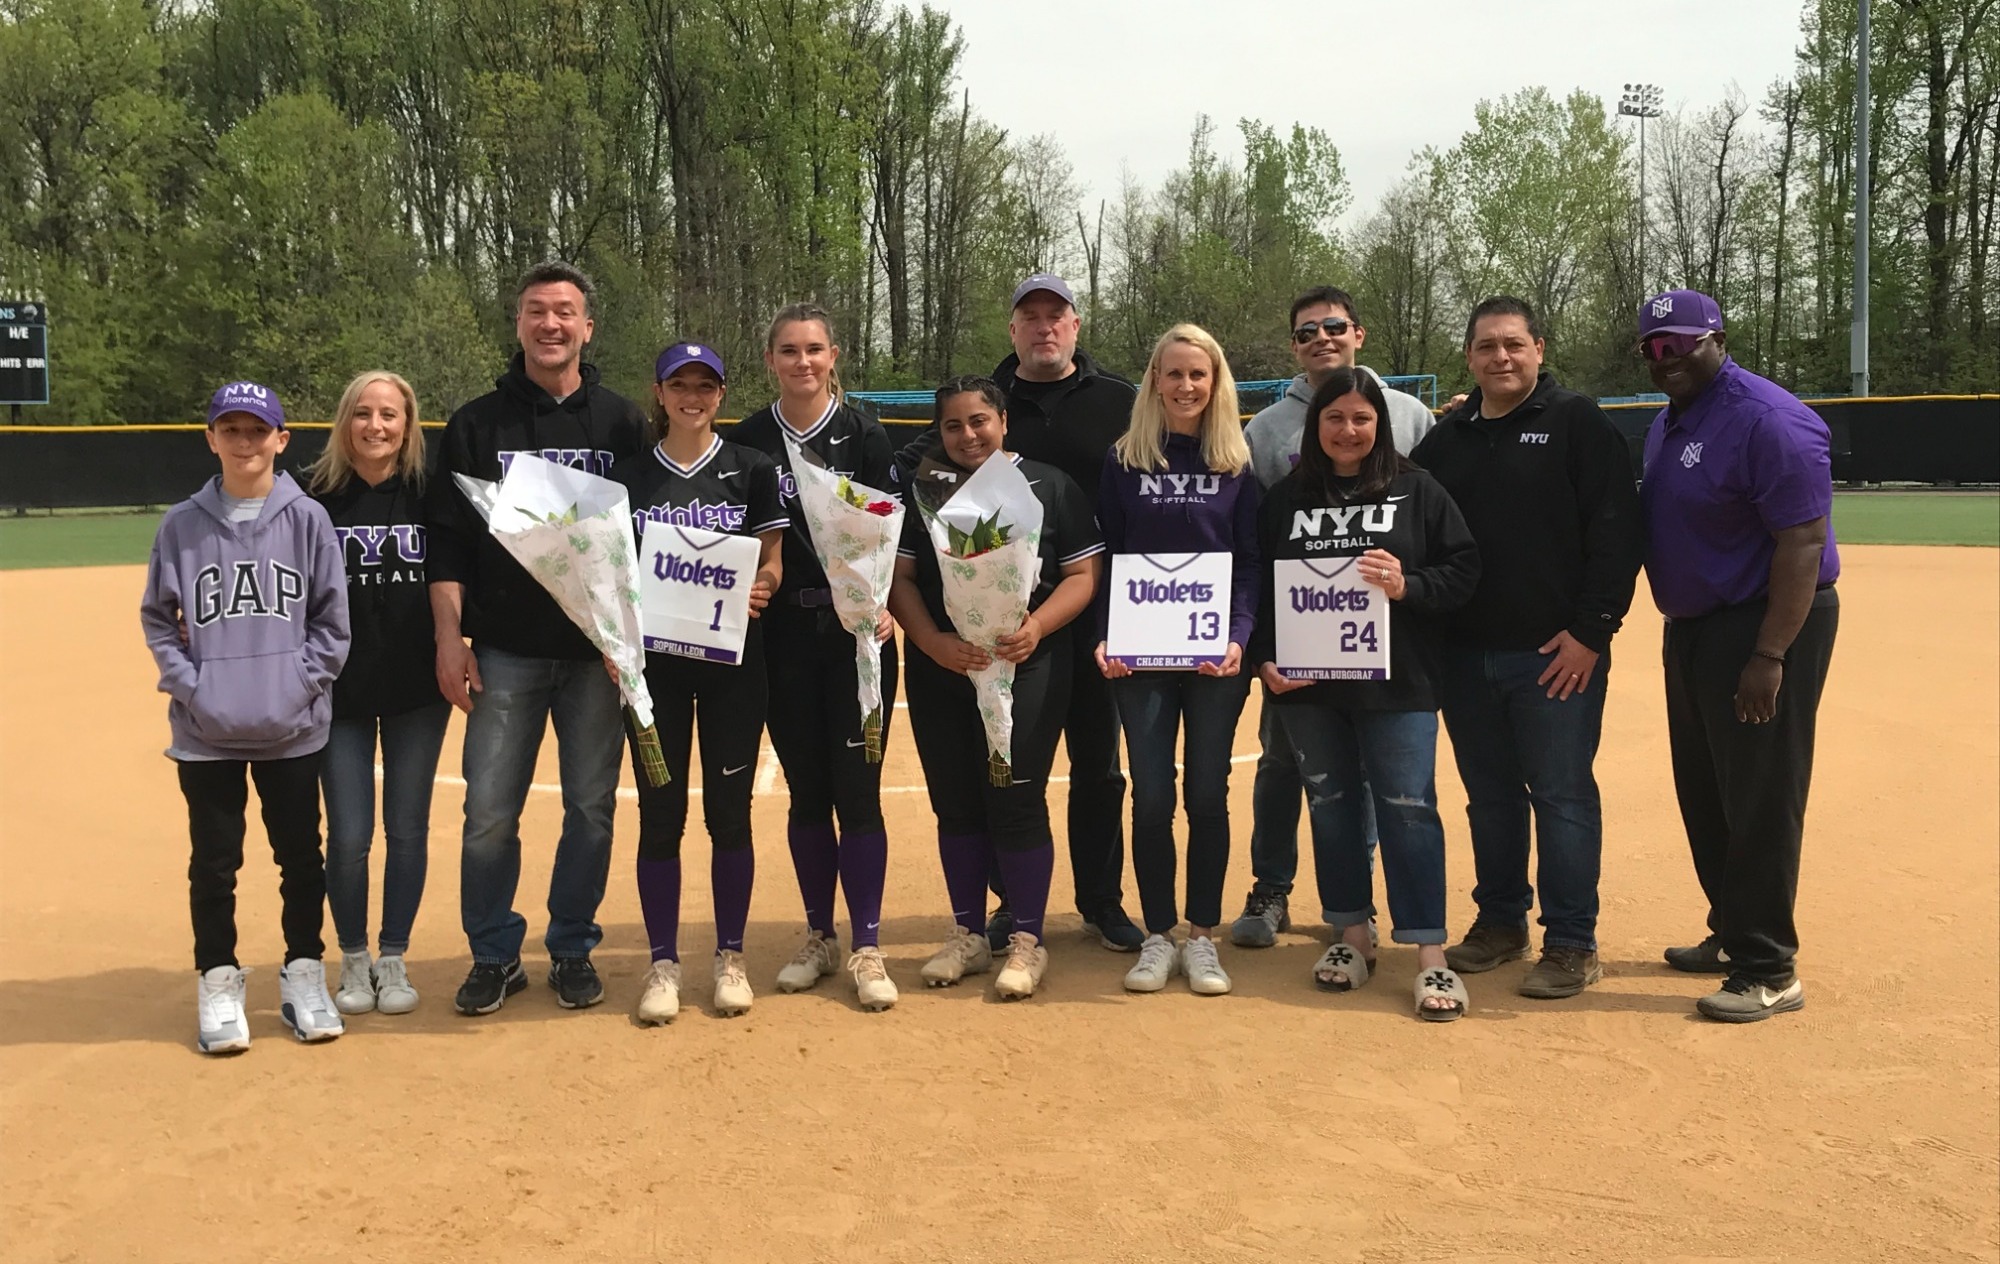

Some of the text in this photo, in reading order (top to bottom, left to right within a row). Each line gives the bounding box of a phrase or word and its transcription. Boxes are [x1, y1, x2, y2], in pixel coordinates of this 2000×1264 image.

[9, 326, 29, 339] H/E
[26, 358, 45, 369] ERR
[224, 383, 267, 399] NYU
[222, 396, 268, 408] Florence
[1519, 433, 1550, 444] NYU
[1139, 474, 1221, 496] NYU
[1152, 496, 1206, 504] SOFTBALL
[1289, 504, 1397, 540] NYU
[1305, 536, 1374, 551] SOFTBALL
[653, 550, 738, 591] Violets
[193, 558, 305, 628] GAP
[1126, 577, 1214, 605] Violets
[1288, 584, 1370, 614] Violets
[709, 599, 723, 631] 1
[1187, 611, 1220, 640] 13
[1340, 621, 1378, 652] 24
[653, 640, 706, 657] SOPHIA LEON
[1136, 657, 1194, 666] CHLOE BLANC
[1286, 669, 1330, 679] SAMANTHA
